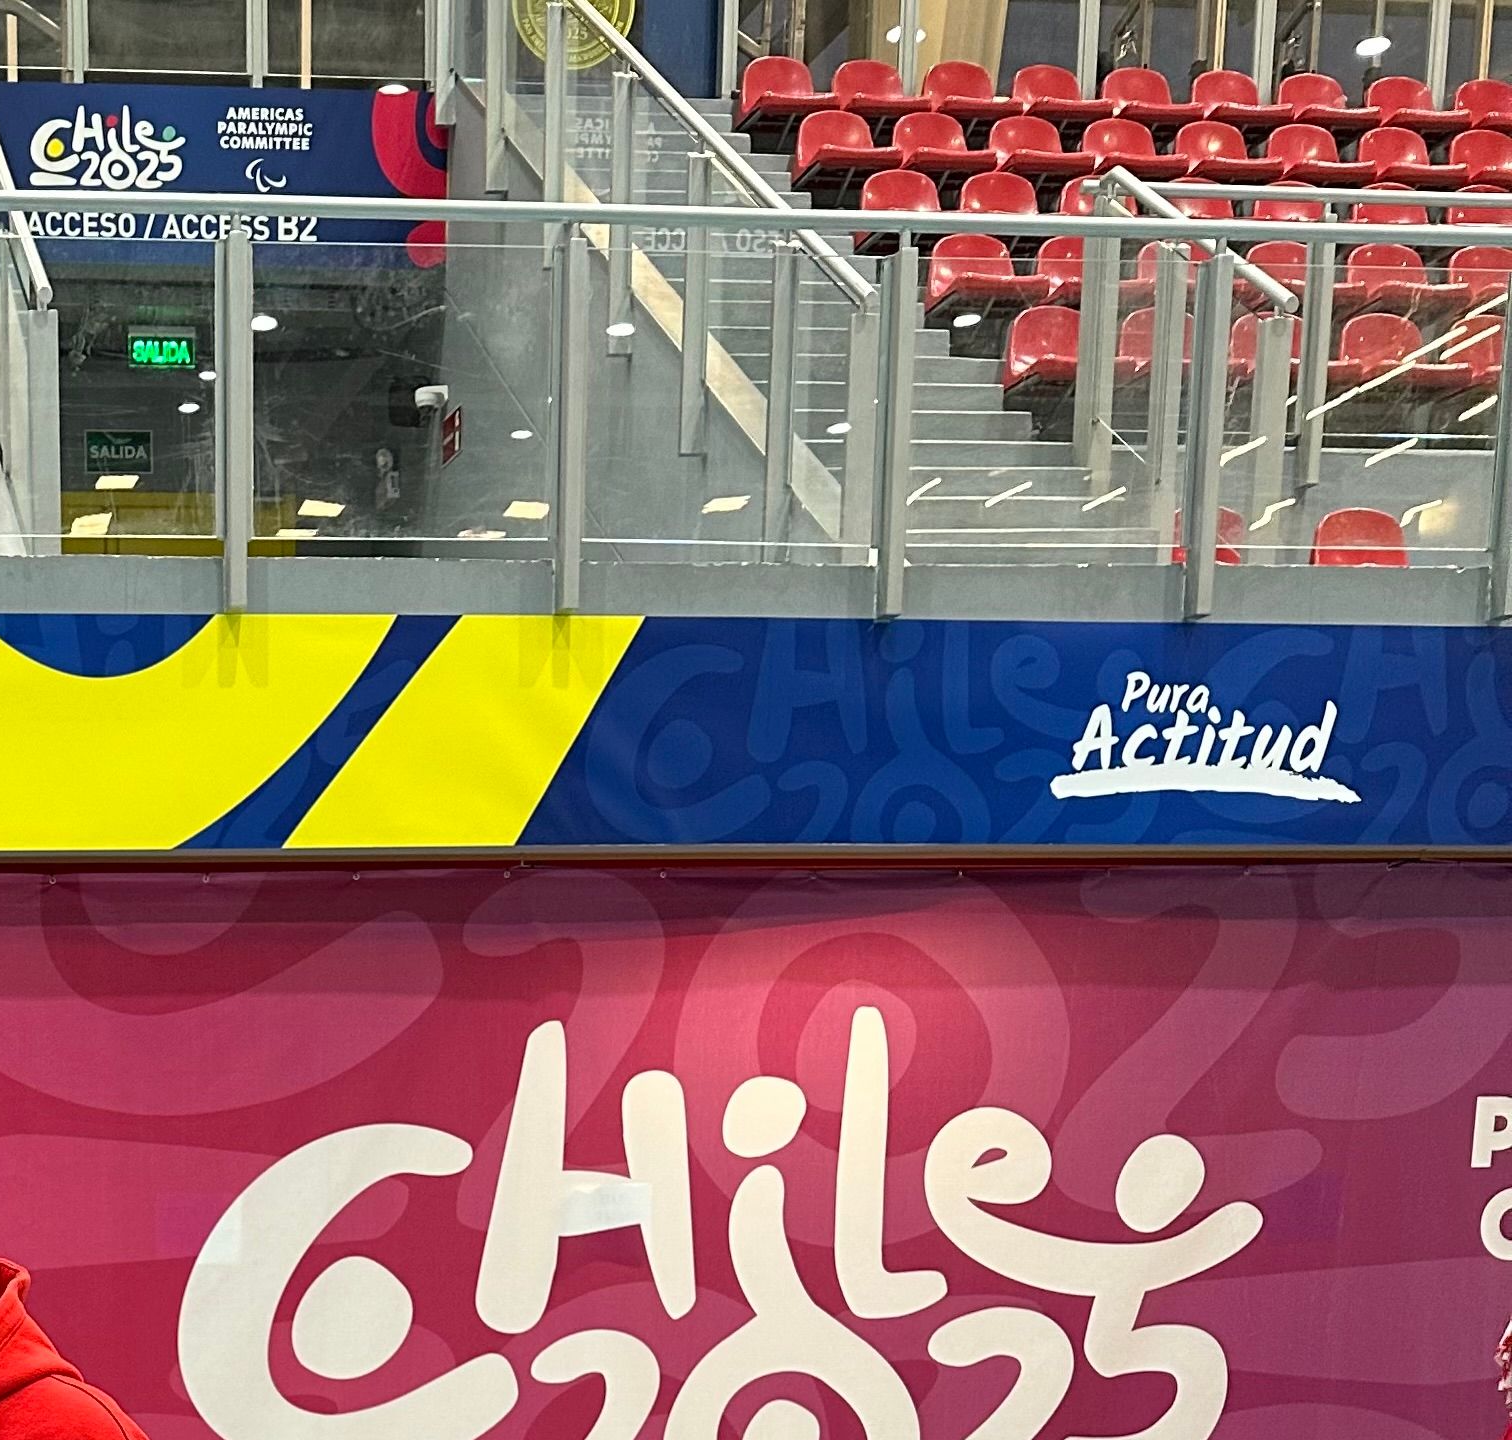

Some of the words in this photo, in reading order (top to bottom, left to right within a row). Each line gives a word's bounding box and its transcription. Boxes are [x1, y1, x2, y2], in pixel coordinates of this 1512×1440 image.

[225, 106, 304, 121] AMERICAS
[217, 121, 313, 137] PARALYMPIC
[219, 135, 310, 151] COMMITTEE
[79, 149, 183, 191] 2025
[28, 211, 137, 238] ACCESO
[143, 213, 156, 239] /
[277, 215, 319, 242] B2
[132, 340, 191, 364] SALIDA
[89, 445, 148, 460] SALIDA
[1120, 670, 1211, 714] Pura
[1071, 699, 1339, 774] Actitud
